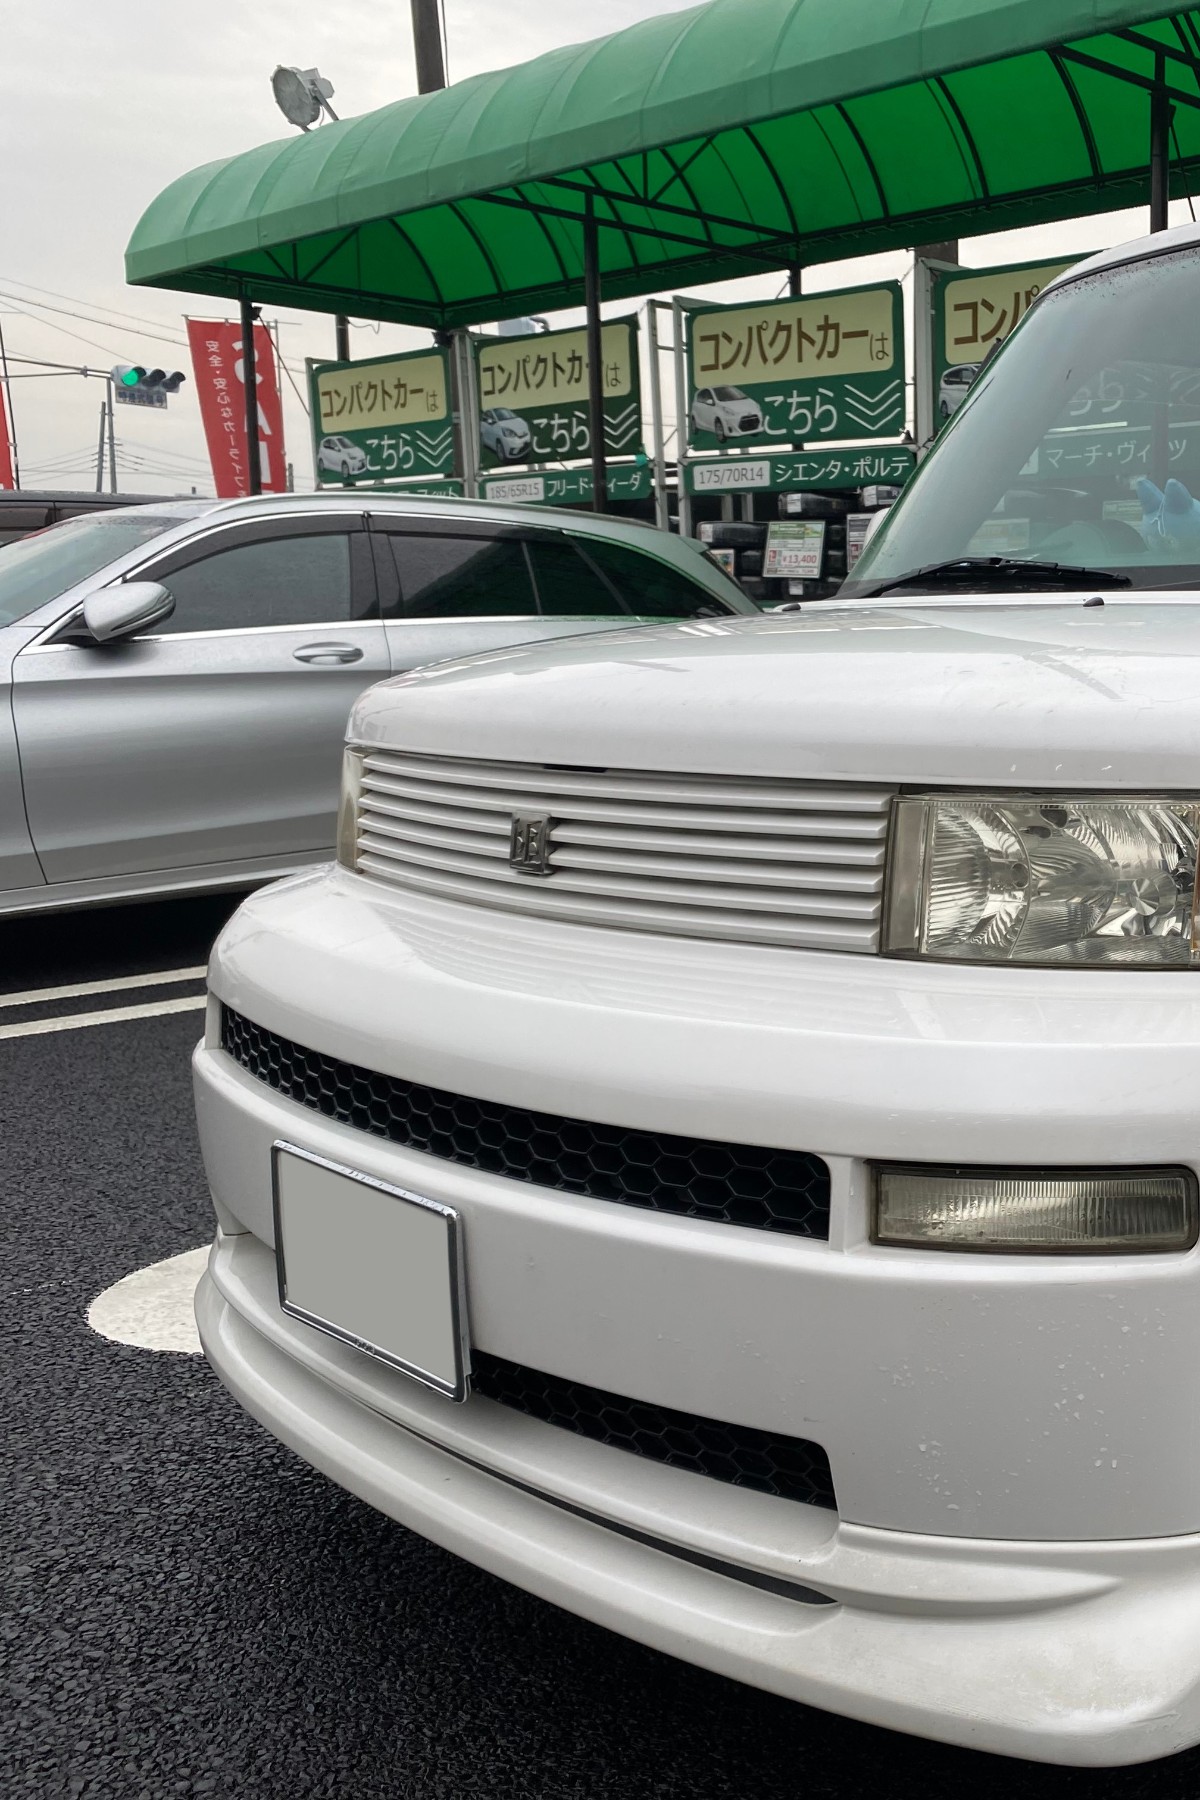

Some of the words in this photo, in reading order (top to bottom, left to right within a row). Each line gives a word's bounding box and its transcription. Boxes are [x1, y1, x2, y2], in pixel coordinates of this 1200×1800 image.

[699, 314, 889, 372] コンパクトカーは
[482, 350, 622, 396] コンパクトカは
[321, 377, 440, 419] コンパクトカーは
[763, 388, 838, 436] こちら
[366, 433, 415, 471] こちら
[532, 411, 591, 454] こちら
[1046, 438, 1188, 469] マーチ・ヴィツ
[490, 482, 541, 499] 185/65R15
[547, 471, 642, 497] フリード・ィーダ
[699, 467, 764, 485] 175/70R14
[775, 456, 910, 483] シエンタ・ポルテ
